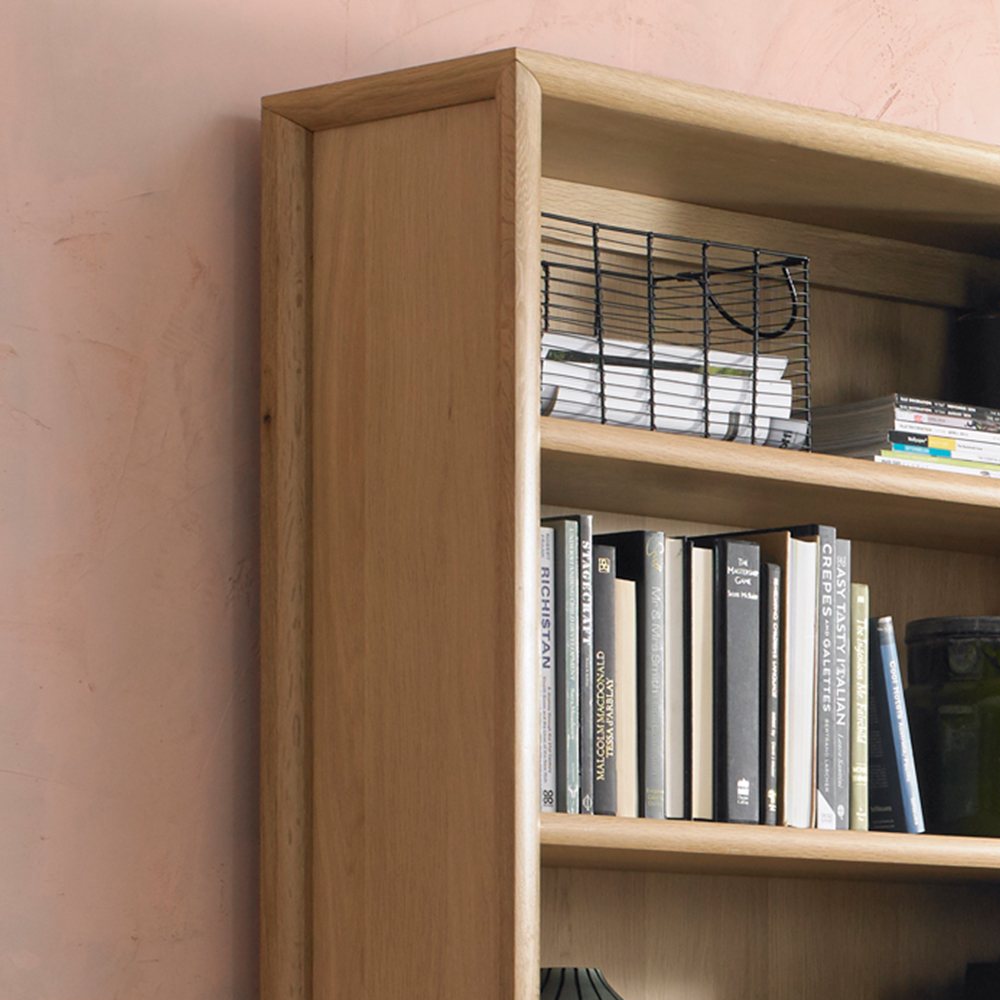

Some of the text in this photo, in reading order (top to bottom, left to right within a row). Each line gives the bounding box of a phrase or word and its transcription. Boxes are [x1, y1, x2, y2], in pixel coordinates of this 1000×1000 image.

[582, 540, 591, 645] STAGECRAFT
[650, 585, 661, 606] Mr
[822, 543, 832, 616] CREPES
[541, 566, 551, 669] RICHISTAN
[650, 608, 661, 619] &
[856, 618, 866, 635] The
[650, 622, 661, 650] Mrs
[836, 556, 847, 725] EASY TASTY ITALIAN
[650, 653, 661, 693] Smith
[822, 639, 832, 712] GALETTES
[888, 660, 898, 683] Cool
[596, 651, 605, 780] MALCOLM MACDONALD
[891, 686, 904, 718] Hotels
[606, 728, 614, 758] TESSA
[856, 702, 867, 744] Fairchild
